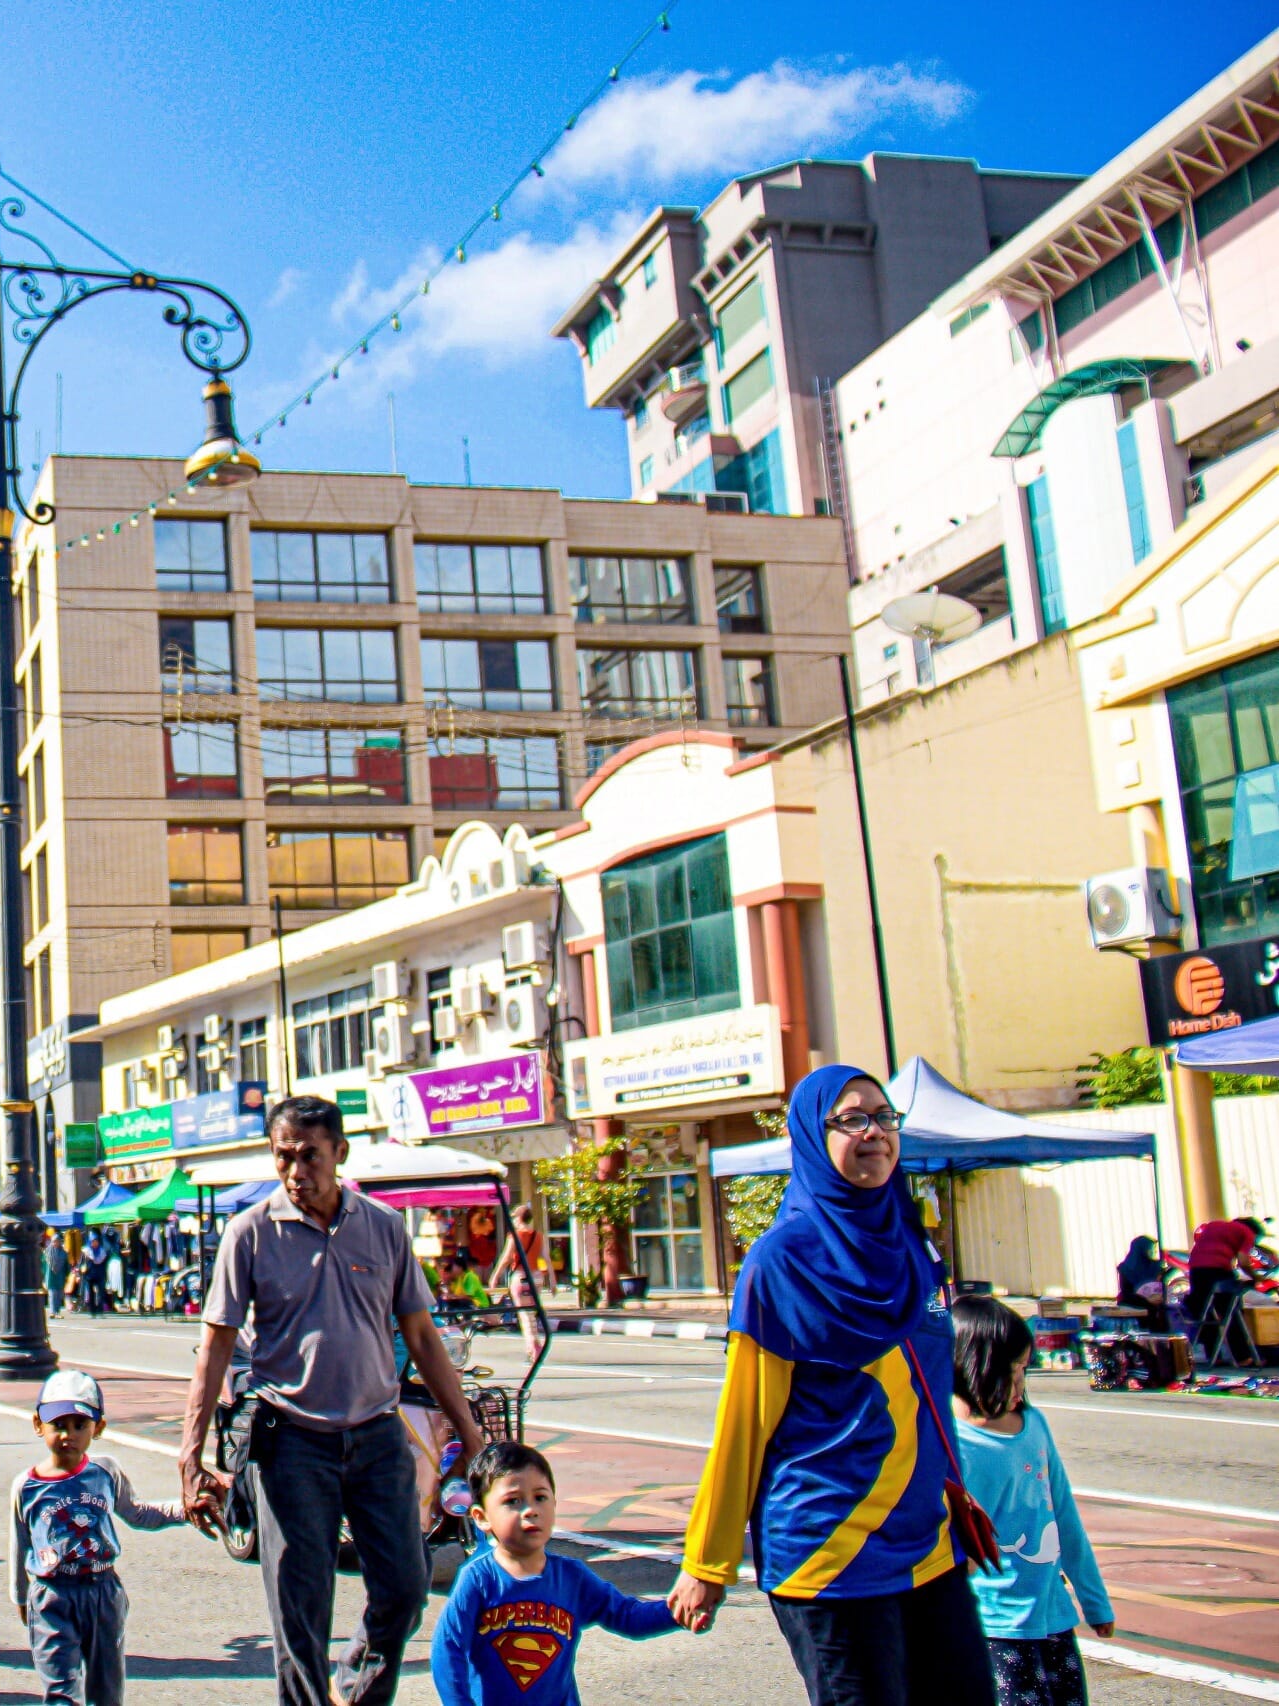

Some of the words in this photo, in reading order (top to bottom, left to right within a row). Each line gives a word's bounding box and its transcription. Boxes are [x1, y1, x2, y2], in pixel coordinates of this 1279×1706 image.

[1169, 1017, 1210, 1037] Home
[1211, 1010, 1242, 1031] Dish
[478, 1601, 575, 1640] SUPERBABY
